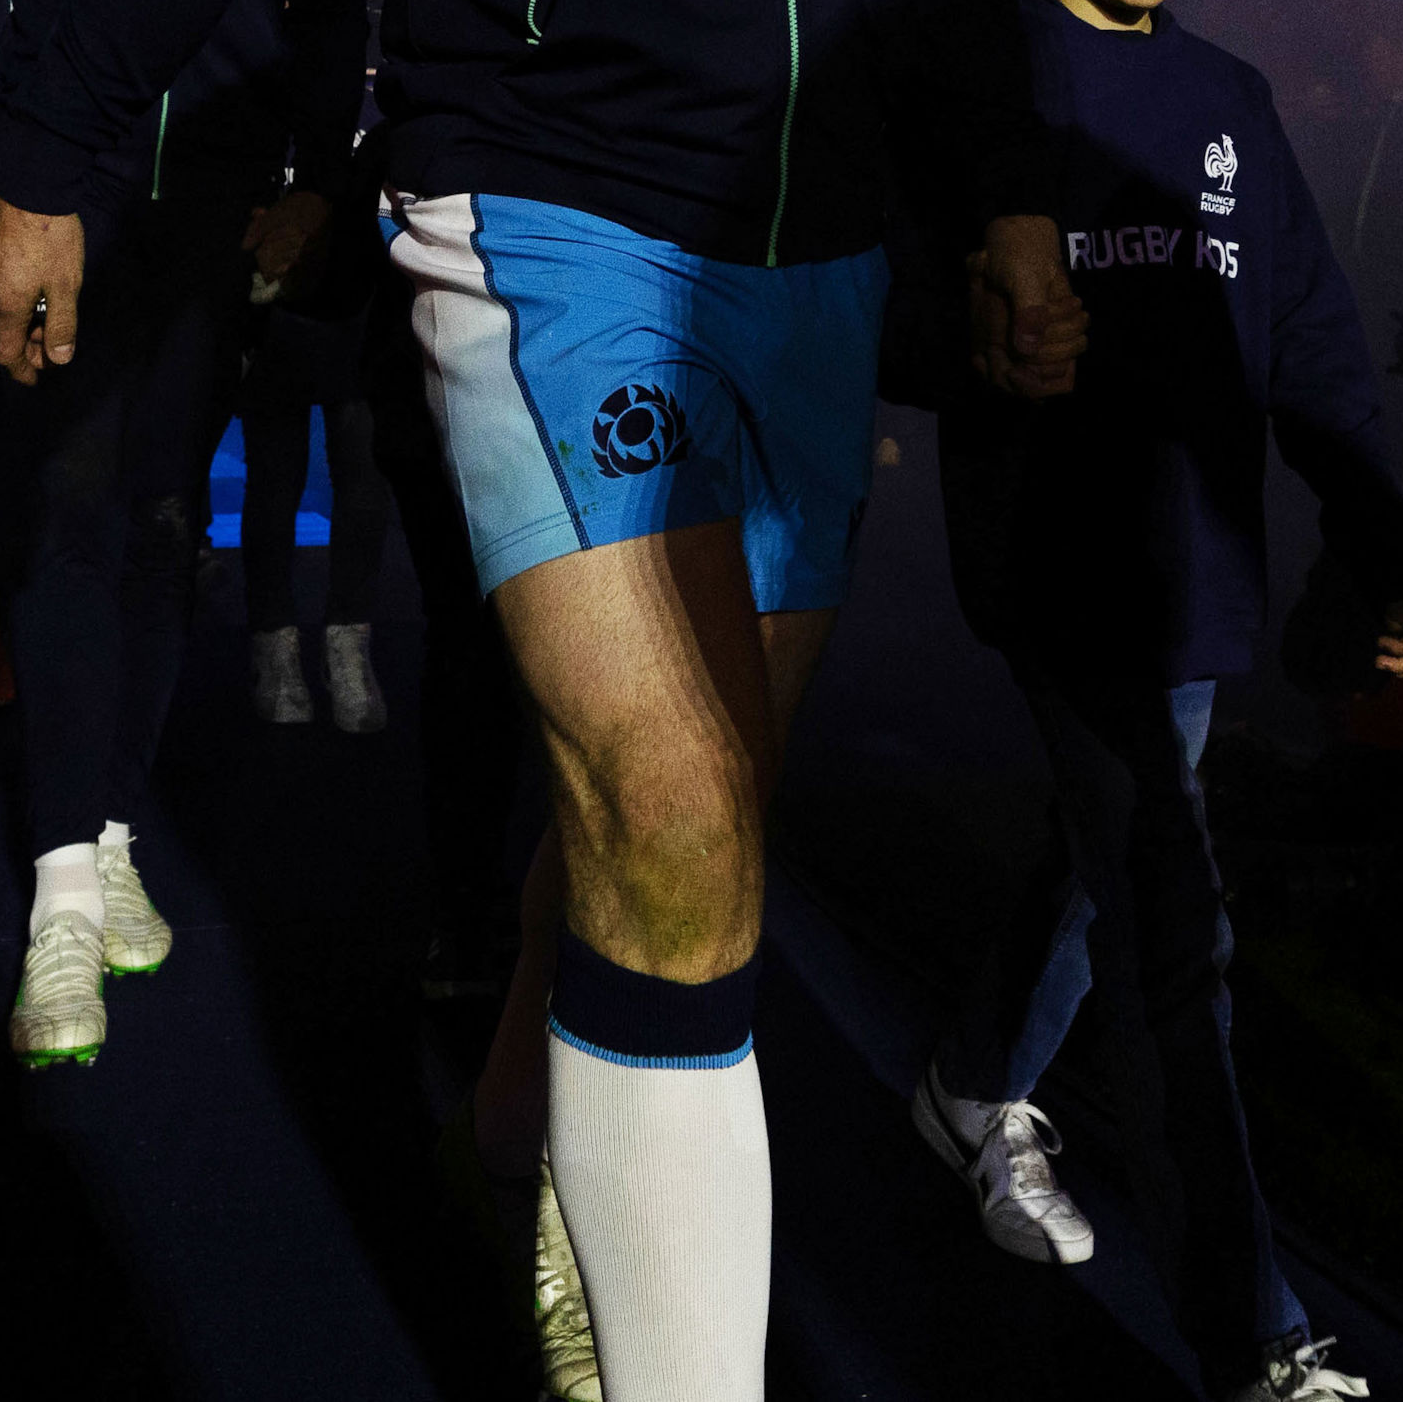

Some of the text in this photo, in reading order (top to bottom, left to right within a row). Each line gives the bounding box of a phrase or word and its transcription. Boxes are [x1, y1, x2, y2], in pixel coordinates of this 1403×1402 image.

[1201, 192, 1236, 207] FRANCE
[1200, 201, 1234, 216] RUGBY
[1067, 225, 1239, 278] RUGBY KDS
